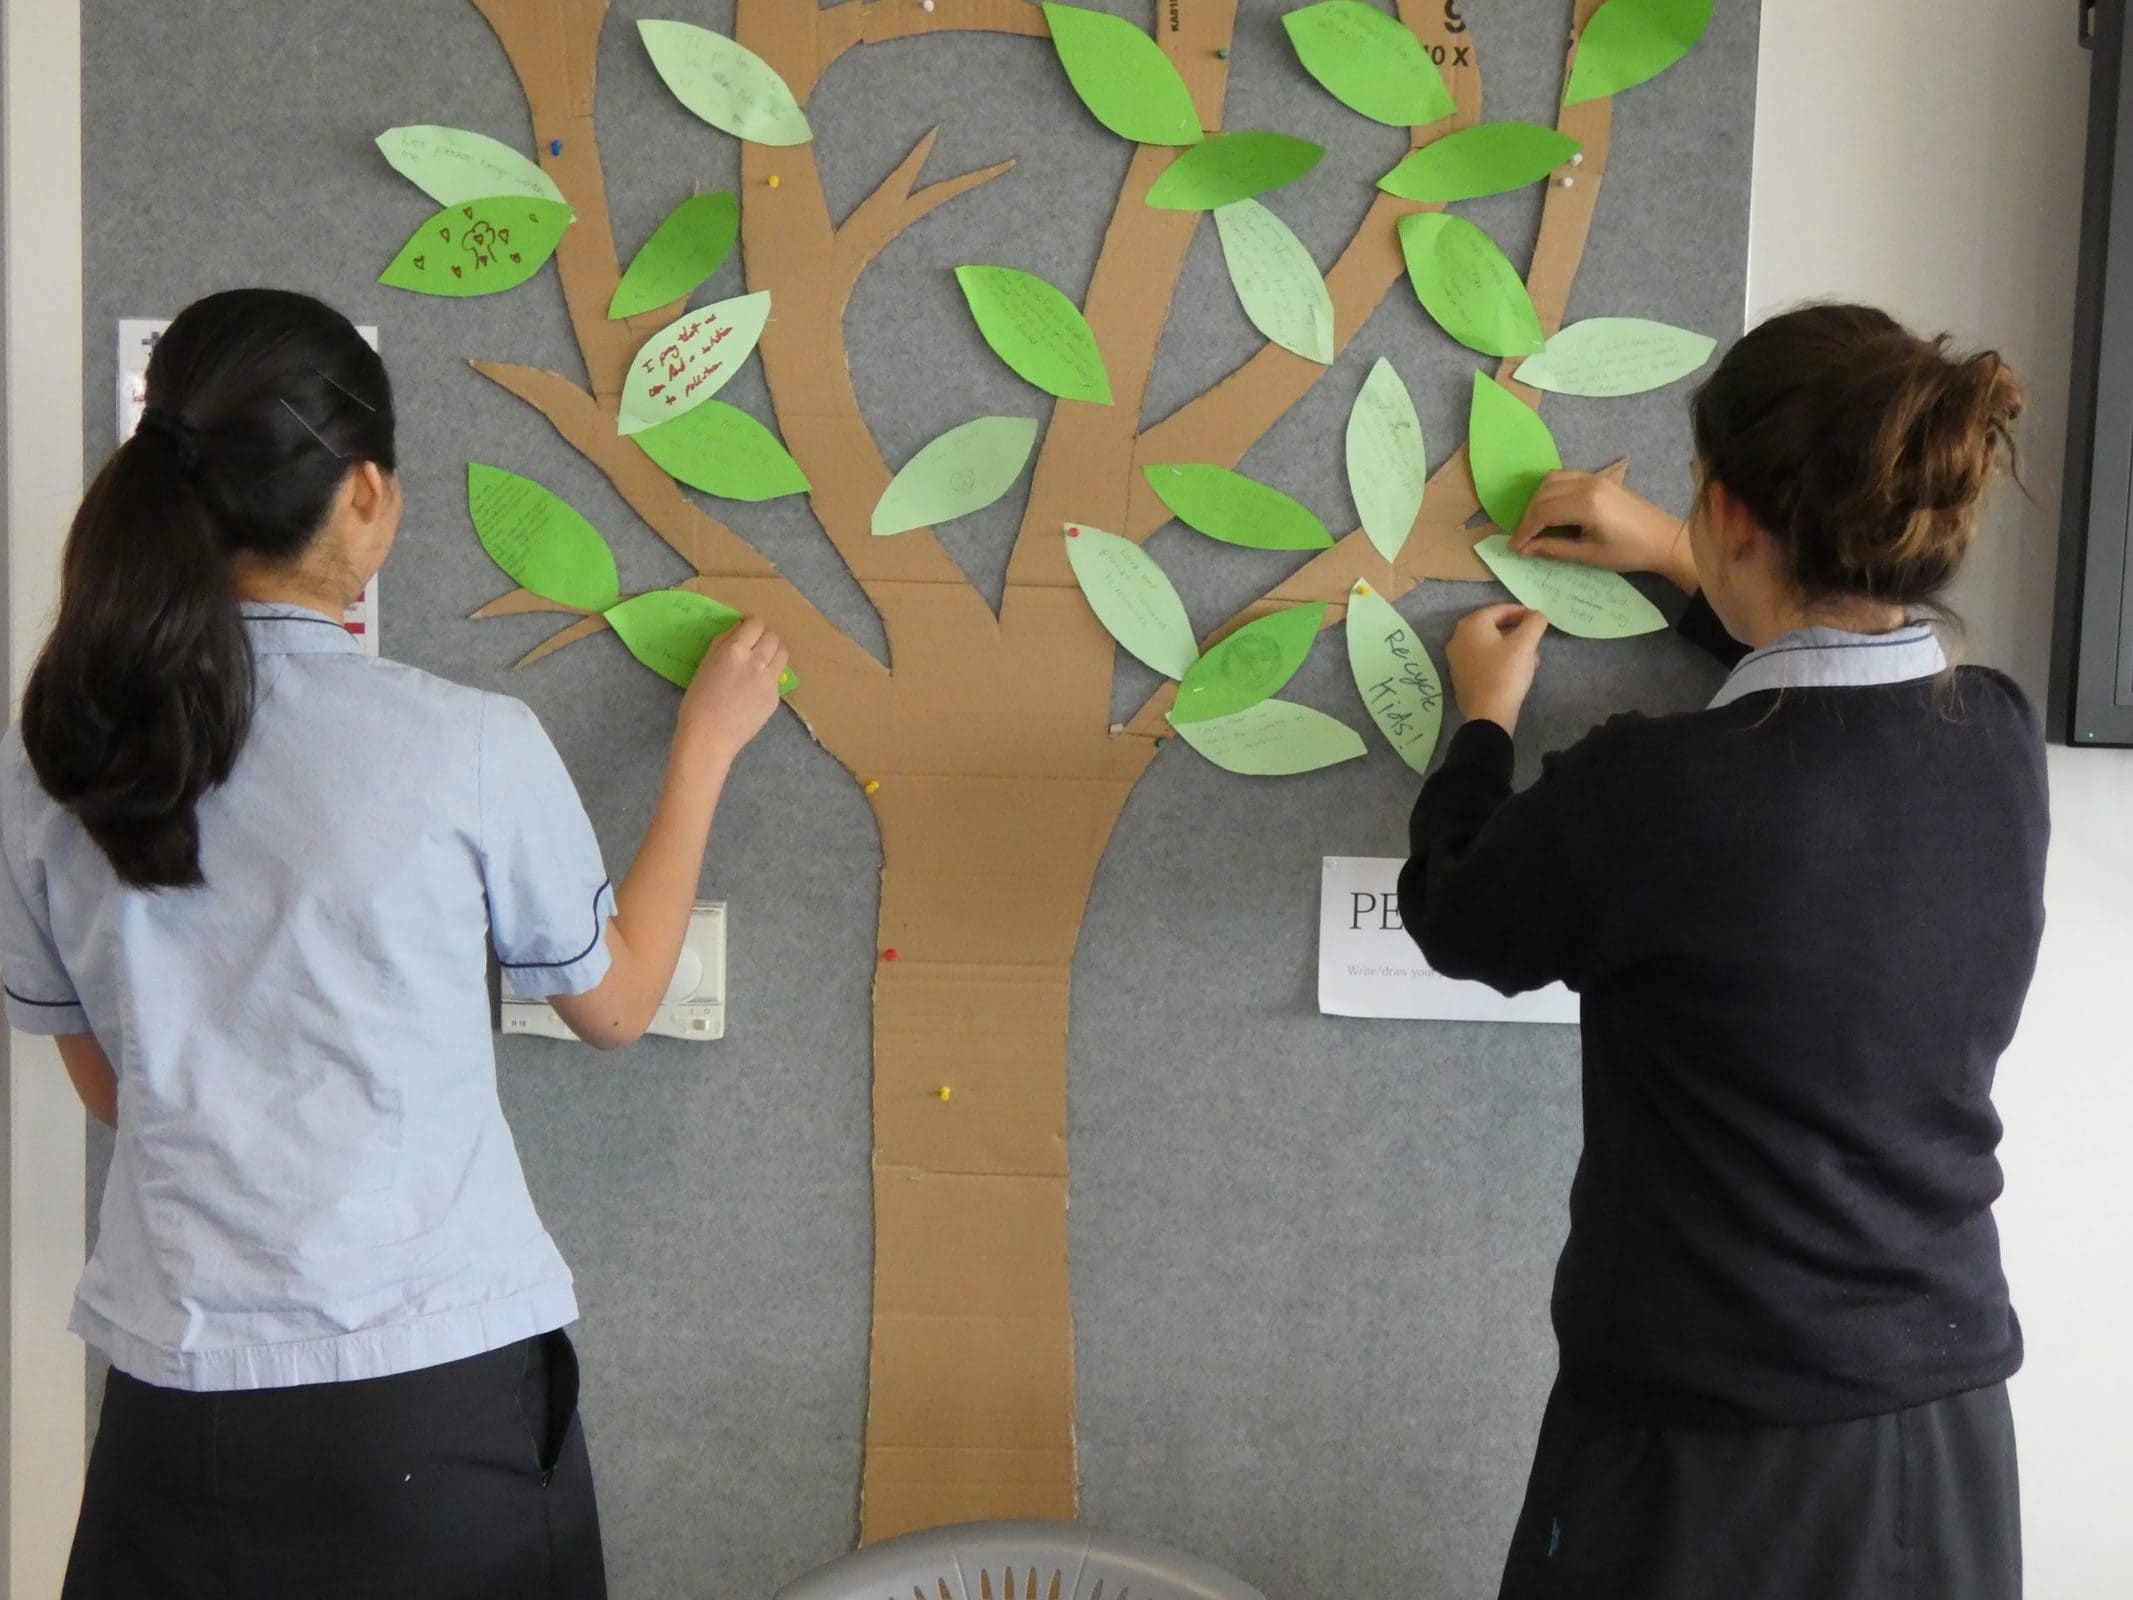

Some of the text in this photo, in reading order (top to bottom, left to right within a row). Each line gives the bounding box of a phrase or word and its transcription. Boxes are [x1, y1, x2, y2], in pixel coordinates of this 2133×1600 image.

[1424, 45, 1445, 66] 0
[642, 359, 654, 374] I
[659, 345, 680, 366] pray
[677, 323, 702, 342] that
[649, 384, 666, 397] can
[702, 327, 733, 354] solution
[665, 362, 723, 405] to pollution
[1384, 629, 1443, 713] Recycle
[1369, 677, 1424, 750] Kids!
[1347, 966, 1408, 978] Write/draw
